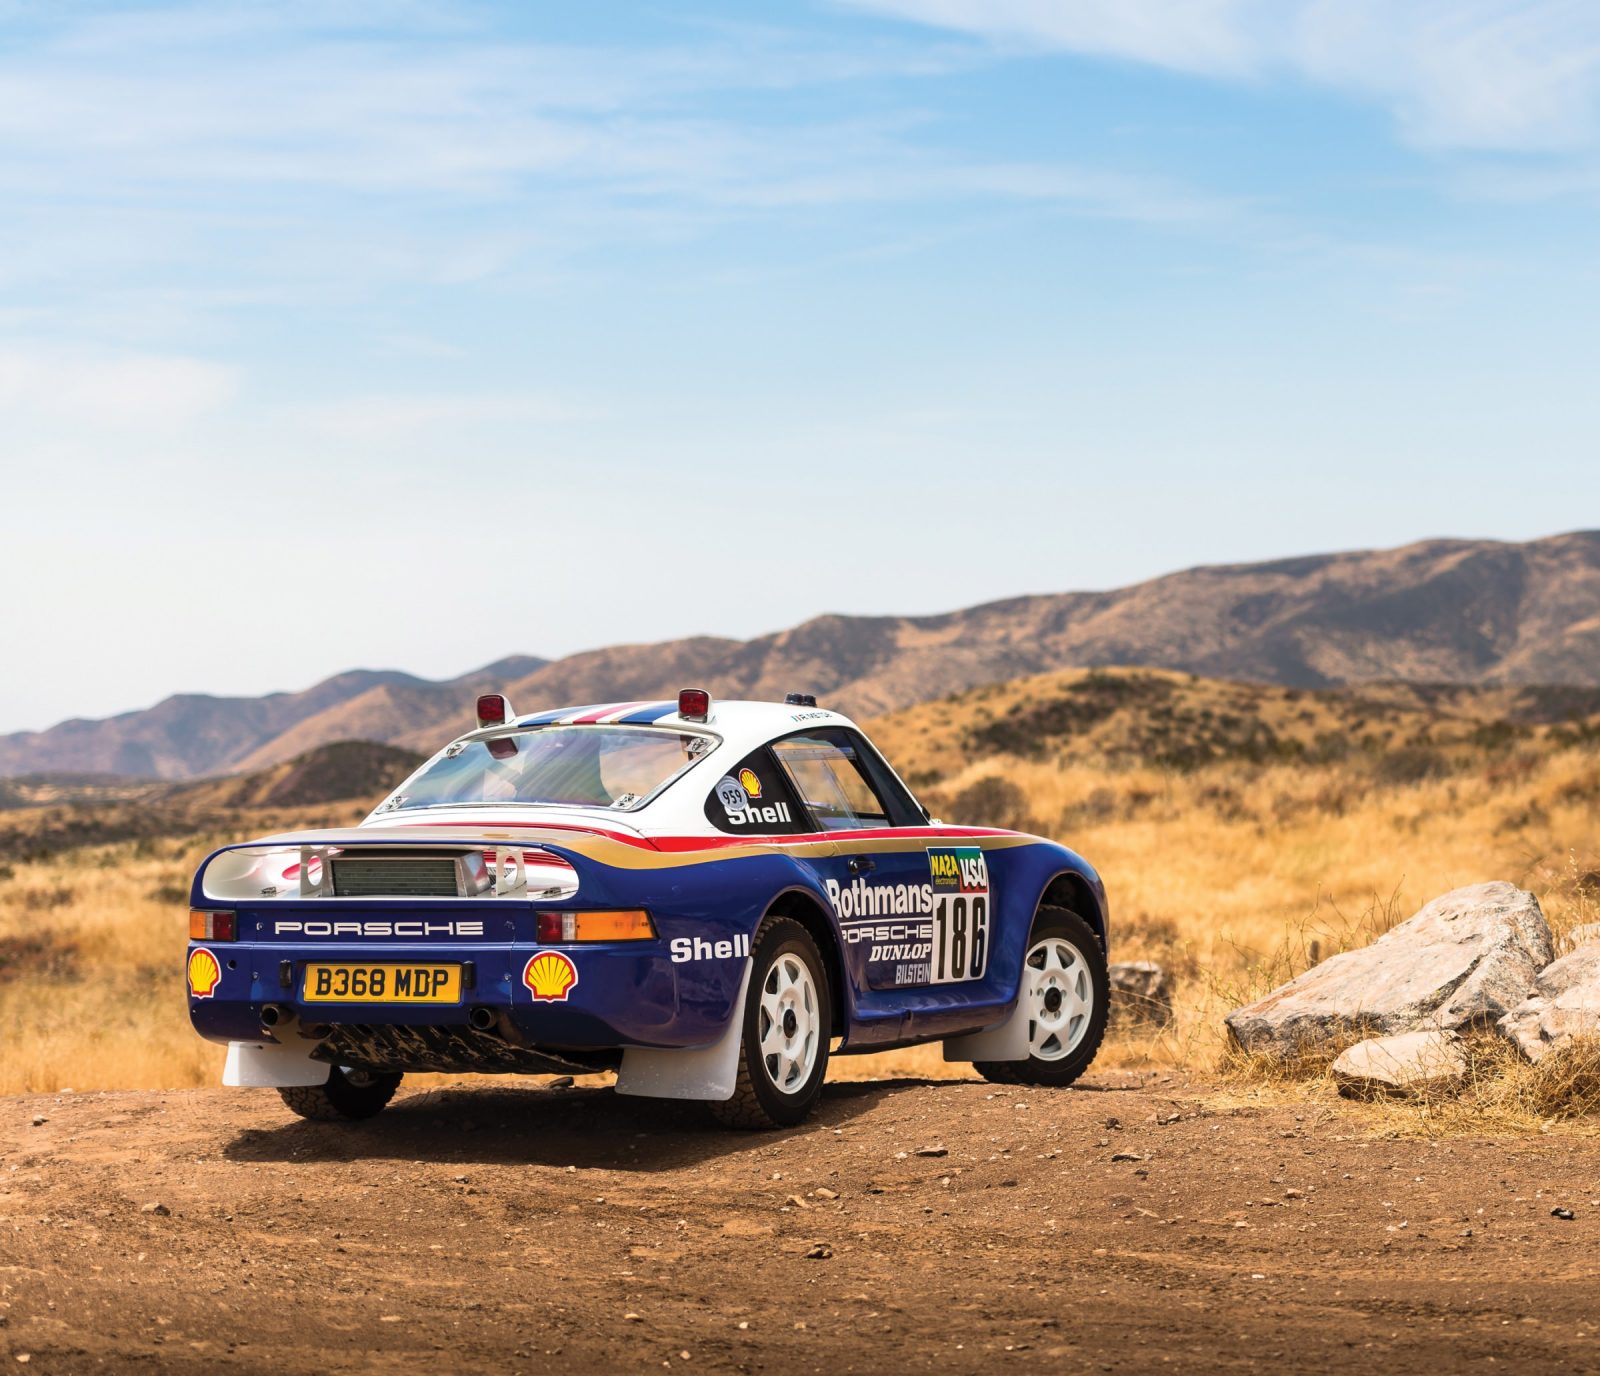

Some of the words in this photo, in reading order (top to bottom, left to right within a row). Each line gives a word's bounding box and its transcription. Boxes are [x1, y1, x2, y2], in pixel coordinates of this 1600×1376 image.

[723, 790, 741, 805] 959
[724, 802, 791, 824] Shell
[826, 878, 933, 918] Rothmans
[275, 922, 483, 935] PORSCHE
[936, 897, 986, 980] 186
[670, 934, 749, 963] Shell
[869, 943, 931, 962] DUNLOP
[315, 968, 385, 996] B368
[394, 969, 448, 996] MDP
[895, 963, 931, 985] BILSTEIN
